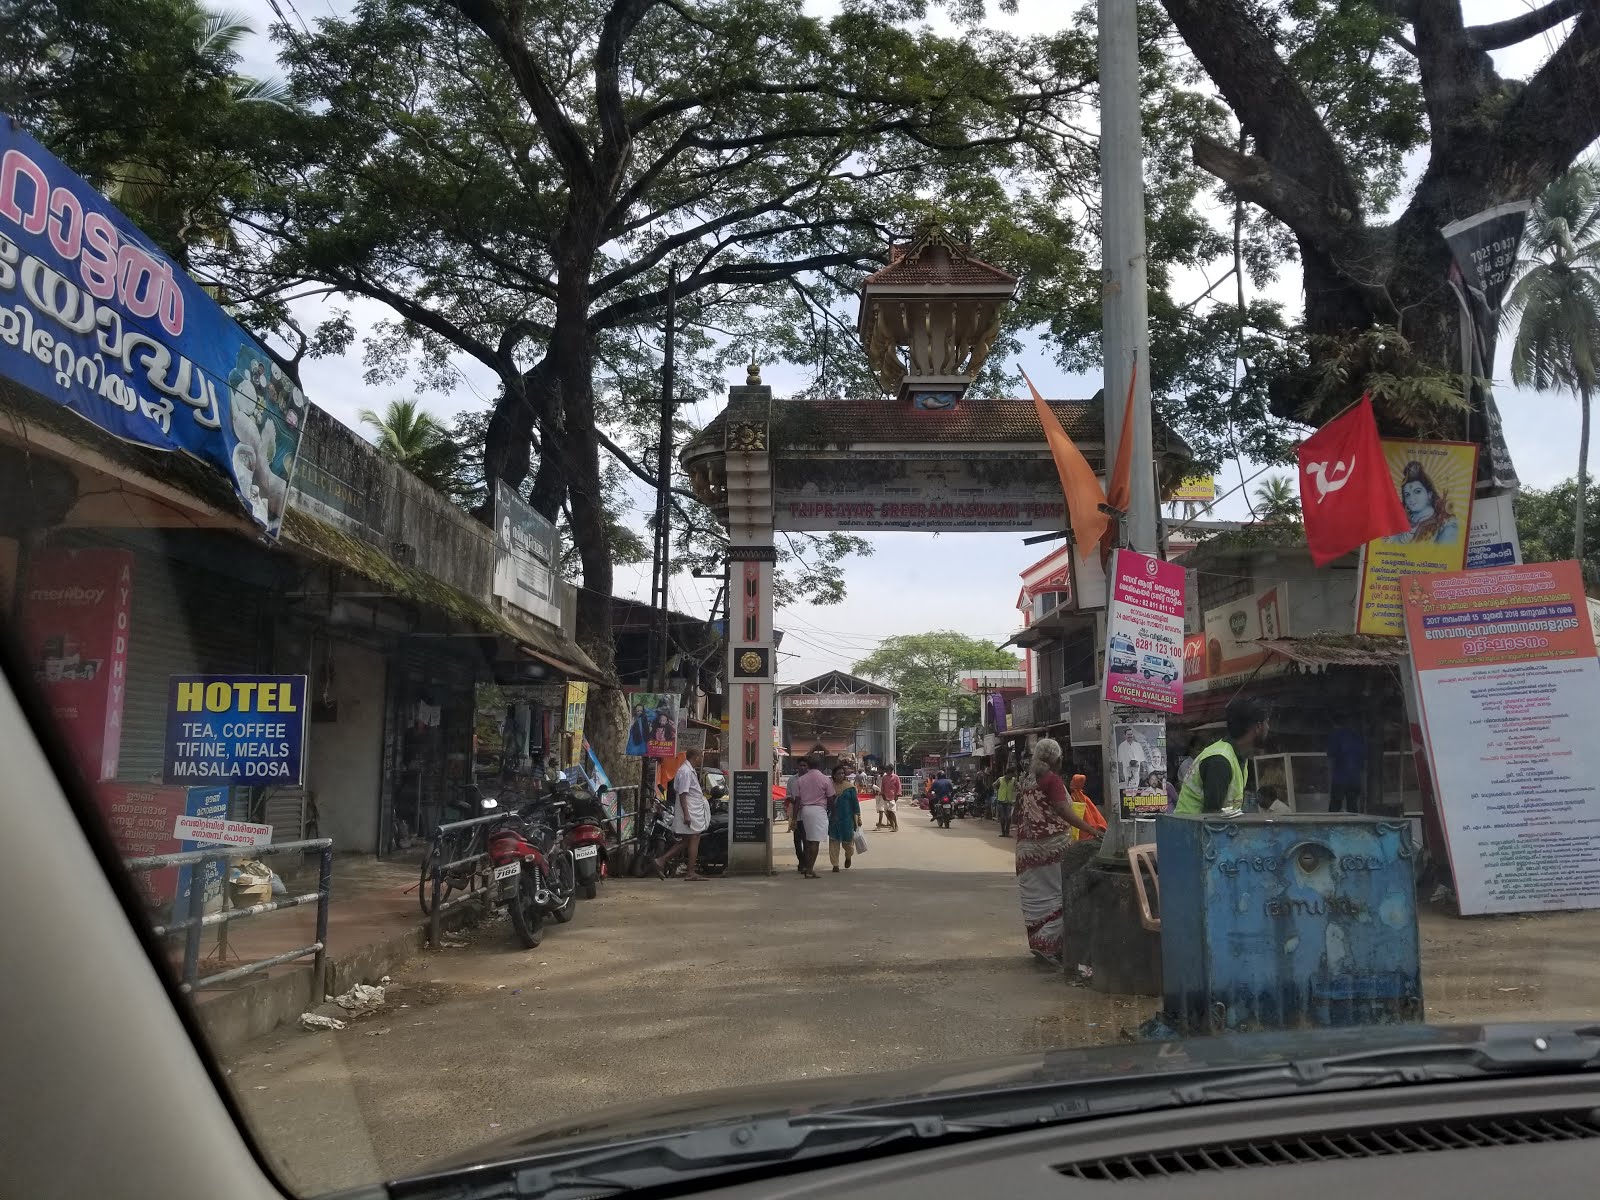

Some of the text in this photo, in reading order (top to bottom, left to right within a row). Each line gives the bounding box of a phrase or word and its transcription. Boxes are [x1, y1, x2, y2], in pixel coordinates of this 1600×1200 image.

[790, 502, 875, 519] TRIPRAYAR
[1024, 502, 1064, 519] TEMP
[1124, 594, 1139, 604] Office
[1426, 616, 1440, 625] 2017
[1505, 609, 1519, 619] 2018
[1135, 638, 1182, 658] 8281 123 100
[176, 682, 297, 713] HOTEL
[1112, 685, 1141, 698] OXYGEN
[1142, 690, 1178, 705] AVAILABLE
[182, 723, 286, 740] TEA, COFFEE
[176, 742, 289, 760] TIFINE, MEALS
[173, 761, 290, 777] MASALA DOSA
[227, 824, 269, 836] ബിരിയാണി
